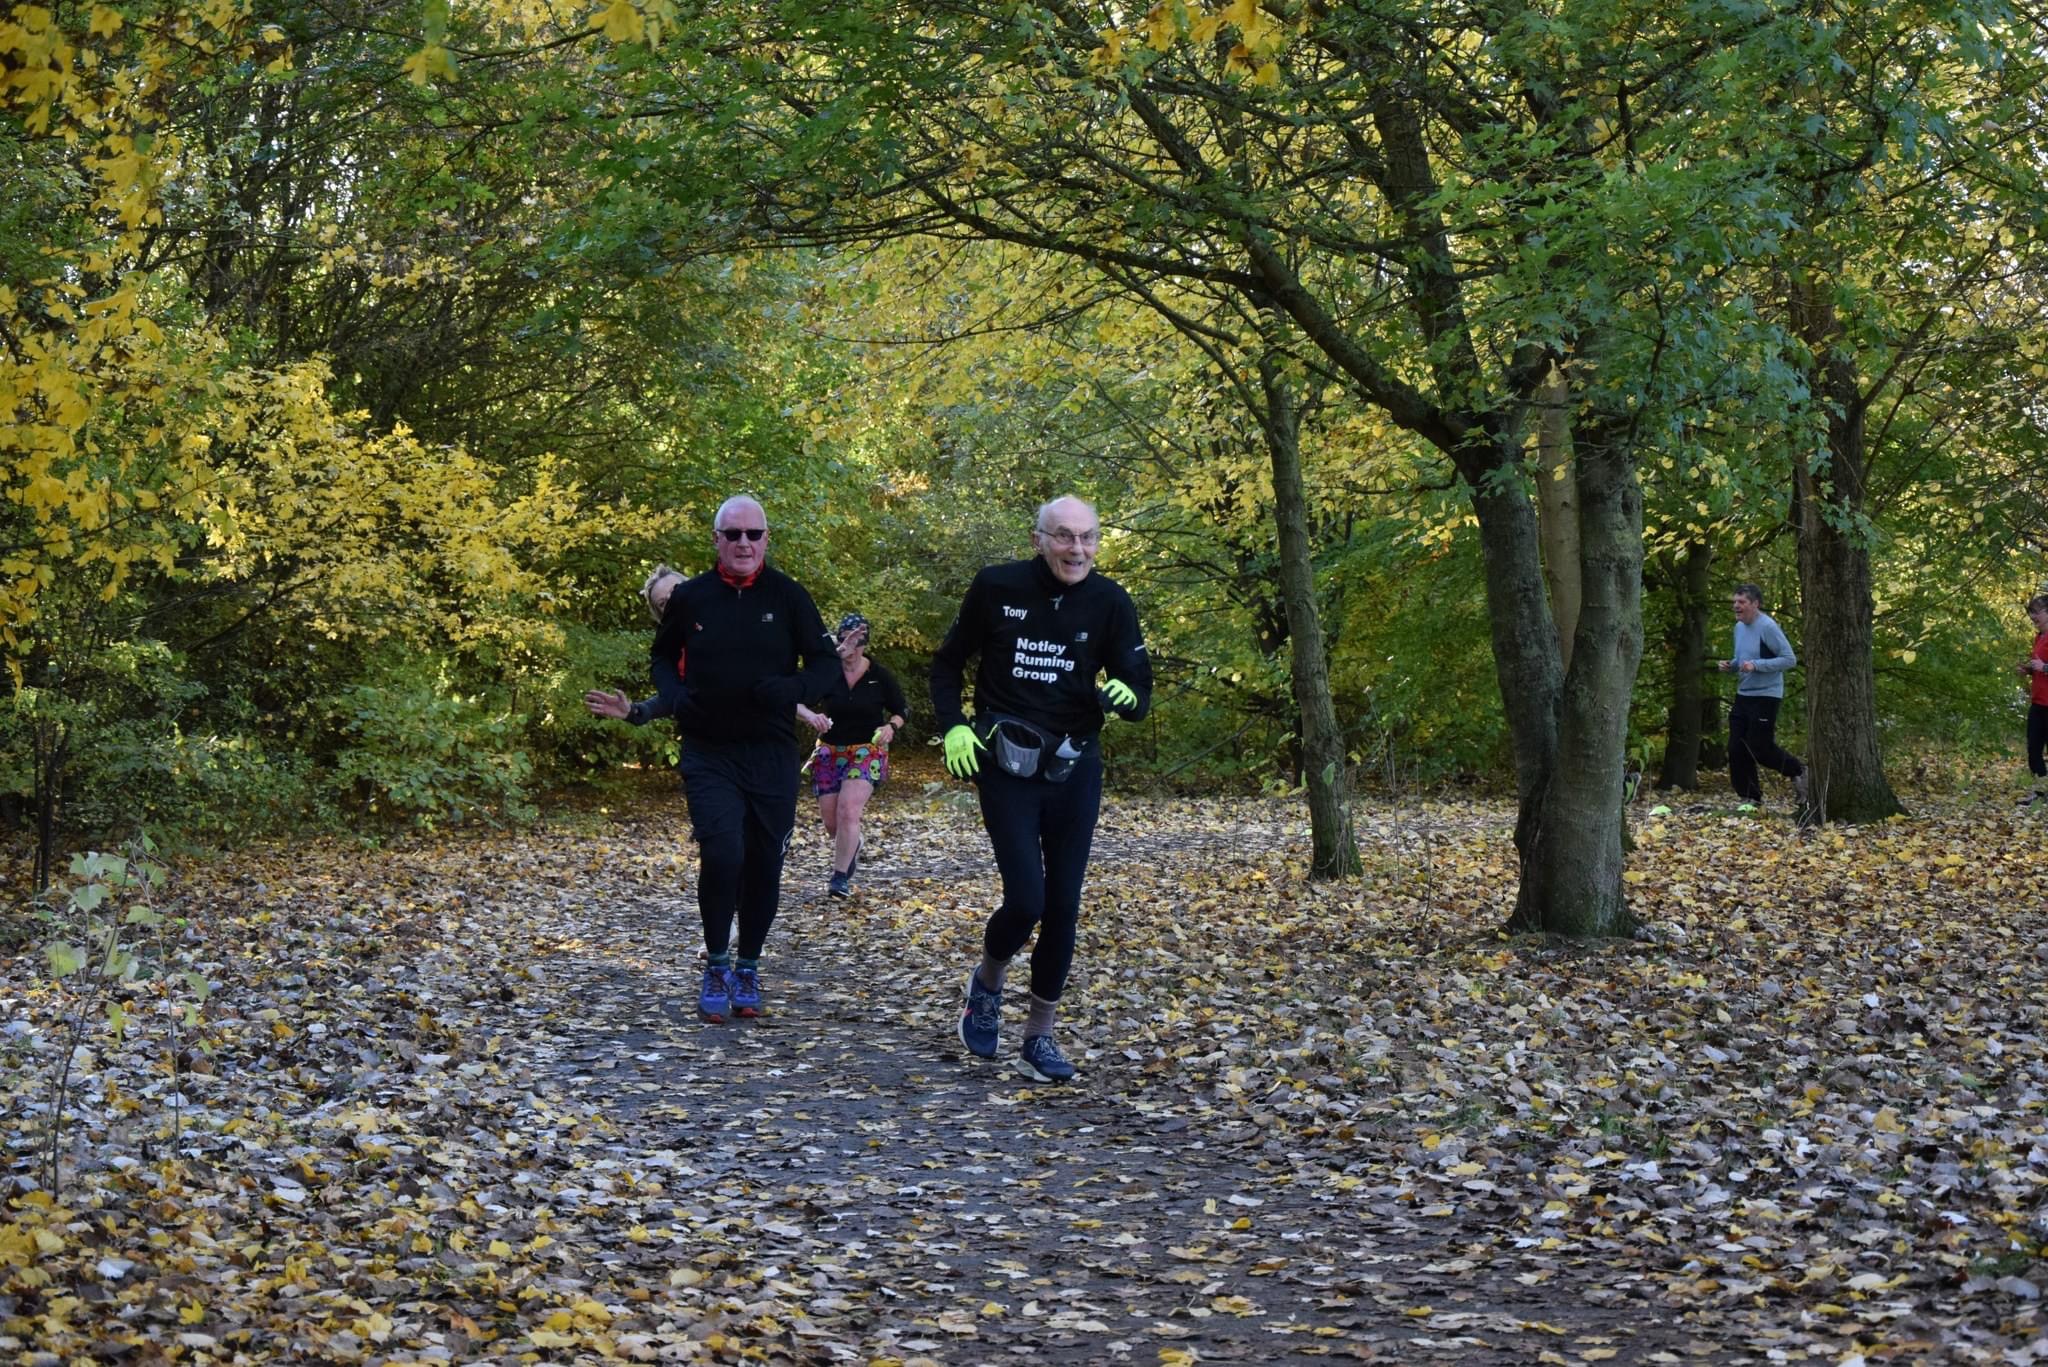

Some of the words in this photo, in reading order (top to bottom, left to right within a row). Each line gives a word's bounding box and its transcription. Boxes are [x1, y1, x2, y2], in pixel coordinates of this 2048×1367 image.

[1002, 605, 1028, 620] Tony
[1016, 637, 1067, 656] Notley
[1014, 651, 1075, 672] Running
[1012, 666, 1058, 684] Group
